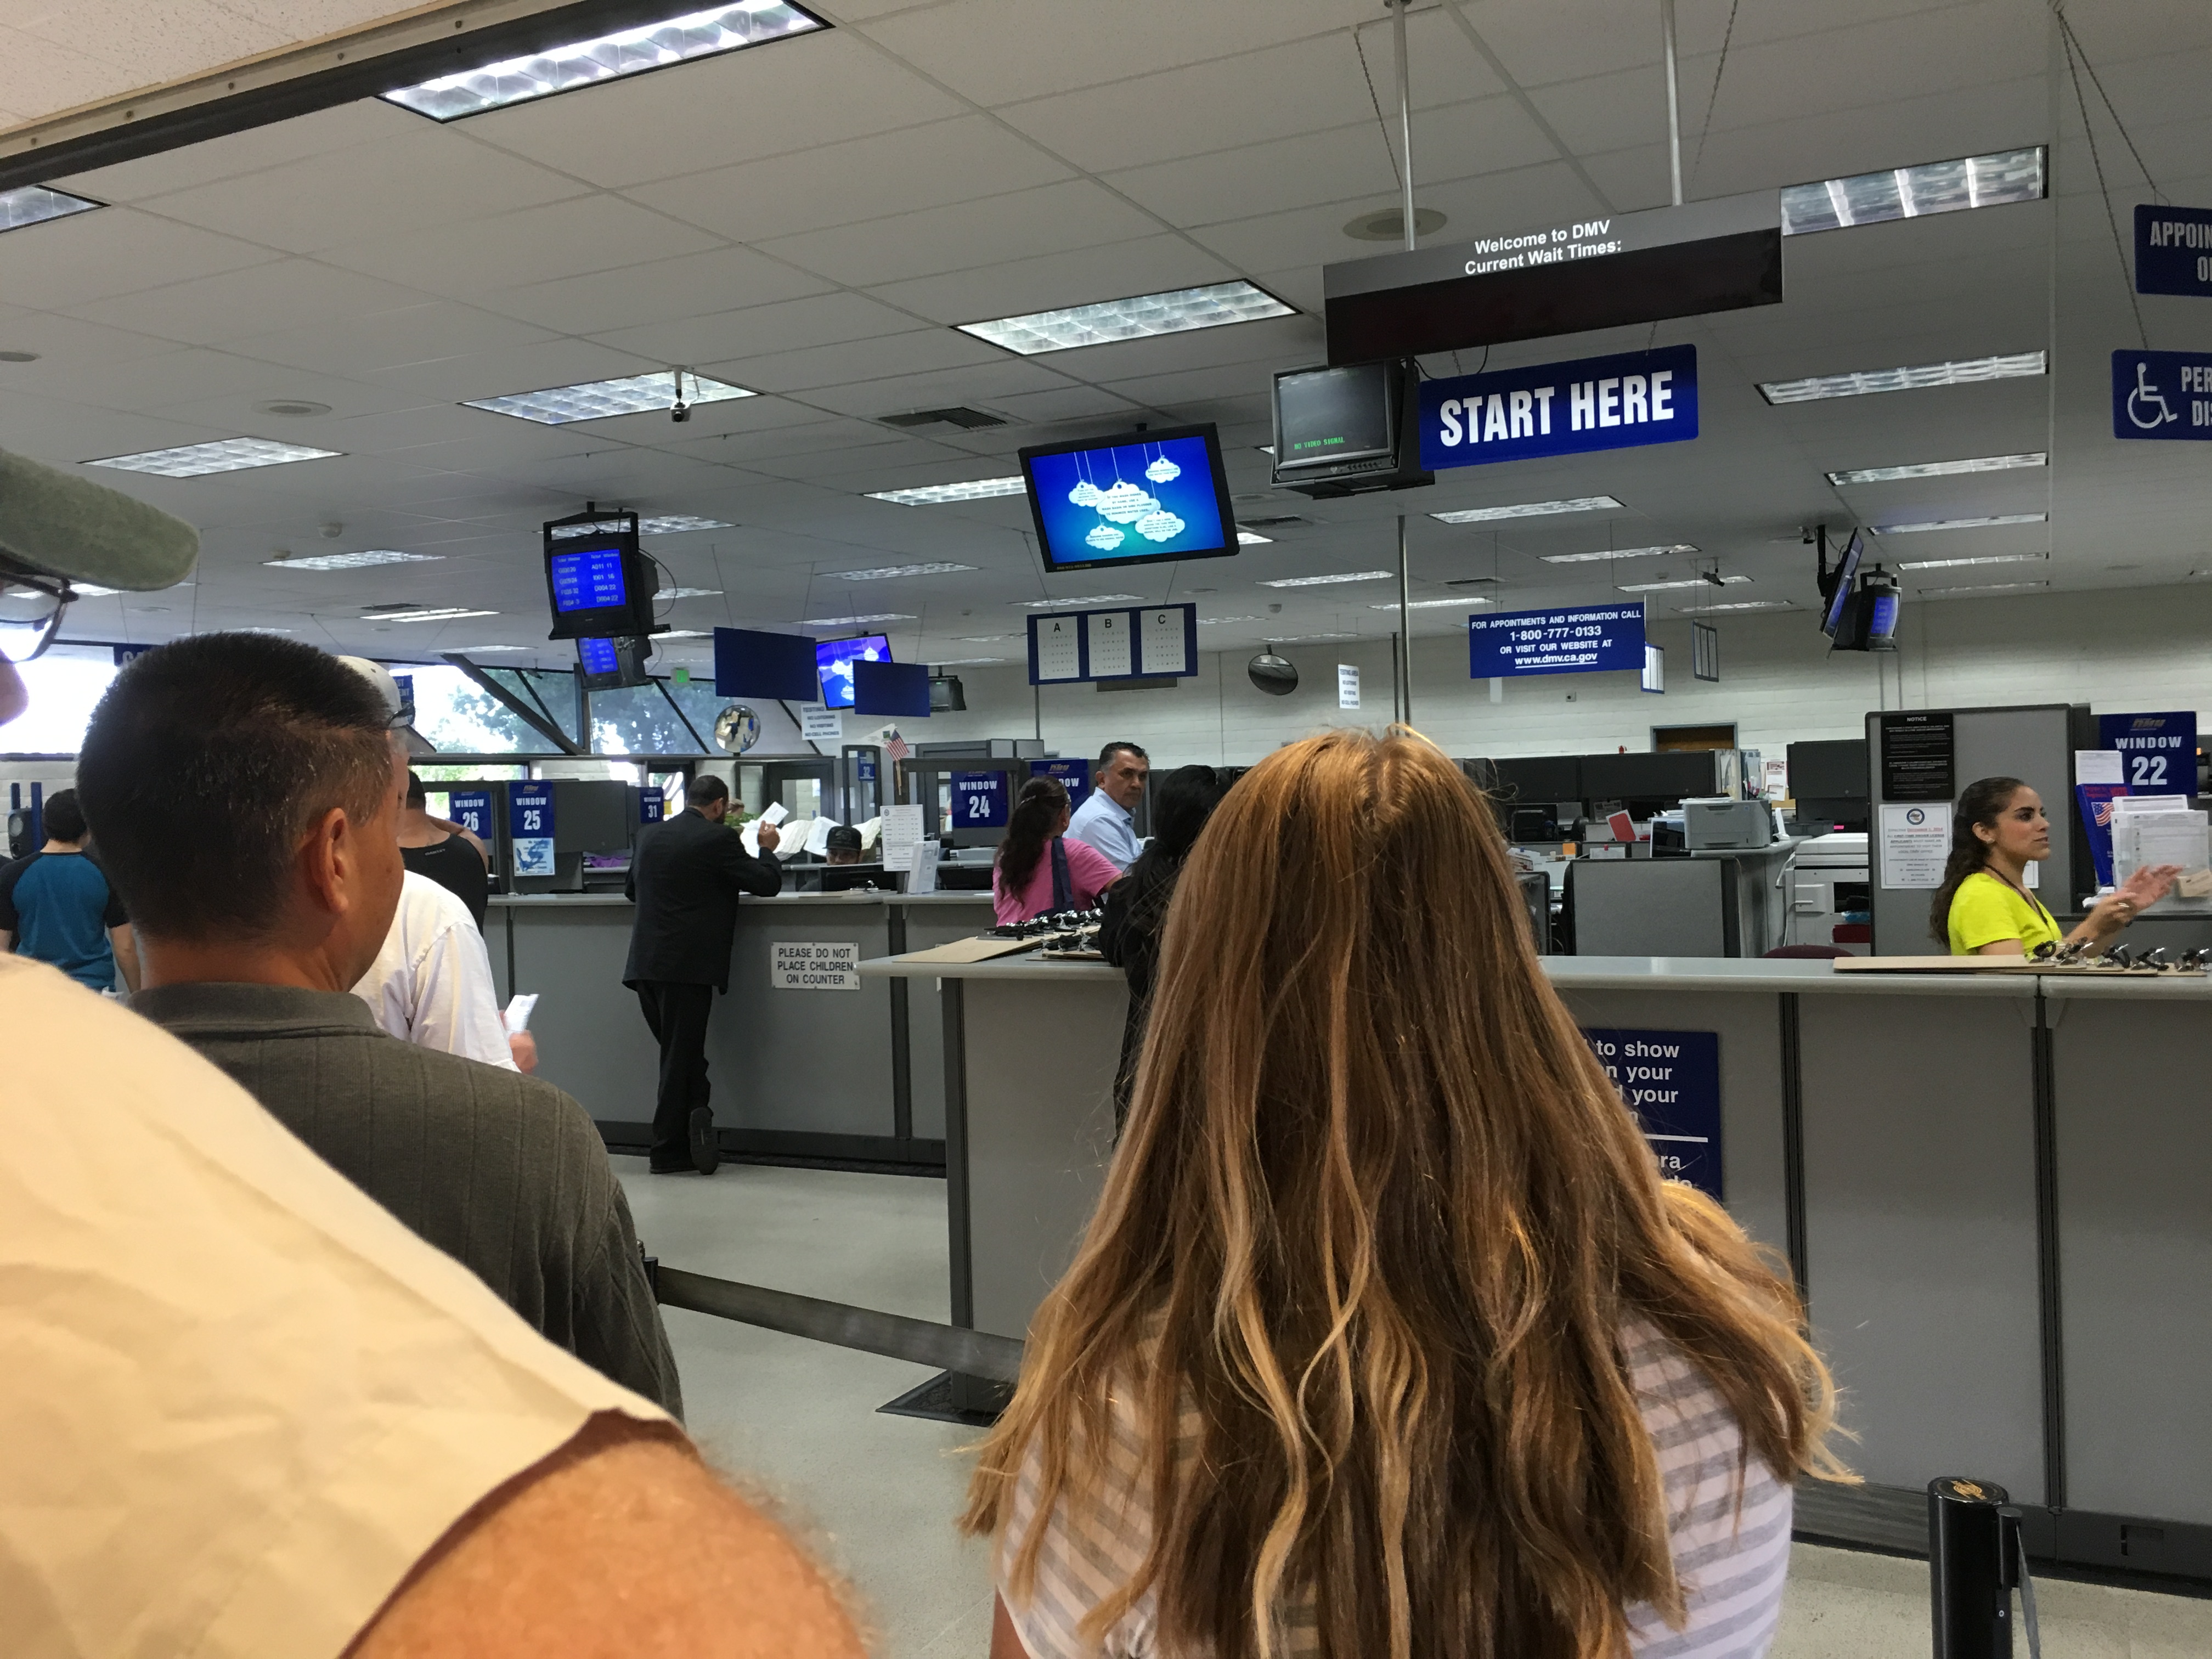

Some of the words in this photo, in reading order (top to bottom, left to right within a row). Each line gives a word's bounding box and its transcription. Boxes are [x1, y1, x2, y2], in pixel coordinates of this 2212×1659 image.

[1475, 233, 1547, 254] Welcome
[1551, 229, 1567, 242] to
[1573, 219, 1610, 239] DMV
[1465, 253, 1523, 274] Current
[1528, 247, 1563, 264] Wait
[1567, 240, 1621, 259] Times:
[1440, 386, 1554, 447] START
[1571, 370, 1674, 431] HERE
[2192, 400, 2212, 426] DI
[1323, 437, 1345, 445] SIGNAL
[1104, 618, 1111, 628] B
[1158, 614, 1166, 624] C
[1489, 617, 1546, 628] APPOINTMENTS
[1549, 616, 1565, 624] AND
[1567, 611, 1618, 623] INFORMATION
[1053, 623, 1061, 632] A
[1510, 625, 1601, 641] 1-800-777-0133
[1499, 646, 1511, 654] OR
[1515, 644, 1536, 653] VISIT
[1539, 643, 1557, 651] OUR
[1561, 641, 1598, 650] WEBSITE
[1602, 639, 1612, 647] AT
[1515, 652, 1598, 665] www.dmv.ca.gov
[2115, 736, 2182, 749] WINDOW
[2131, 755, 2167, 785] 22
[959, 781, 997, 791] WINDOW
[1058, 778, 1079, 787] DOW
[455, 799, 484, 808] WINDOW
[516, 797, 546, 805] WINDOW
[969, 795, 990, 818] 24
[648, 805, 657, 817] 31
[462, 811, 479, 831] 26
[524, 810, 540, 830] 25
[778, 948, 812, 957] PLEASE
[816, 949, 828, 958] DO
[833, 949, 851, 958] NOT
[777, 961, 805, 970] PLACE
[810, 961, 853, 971] CHILDREN
[786, 974, 799, 983] ON
[803, 974, 844, 984] COUNTER
[1596, 1040, 1616, 1056] to
[1624, 1041, 1679, 1058] show
[1626, 1066, 1672, 1083] your
[1632, 1088, 1678, 1105] your
